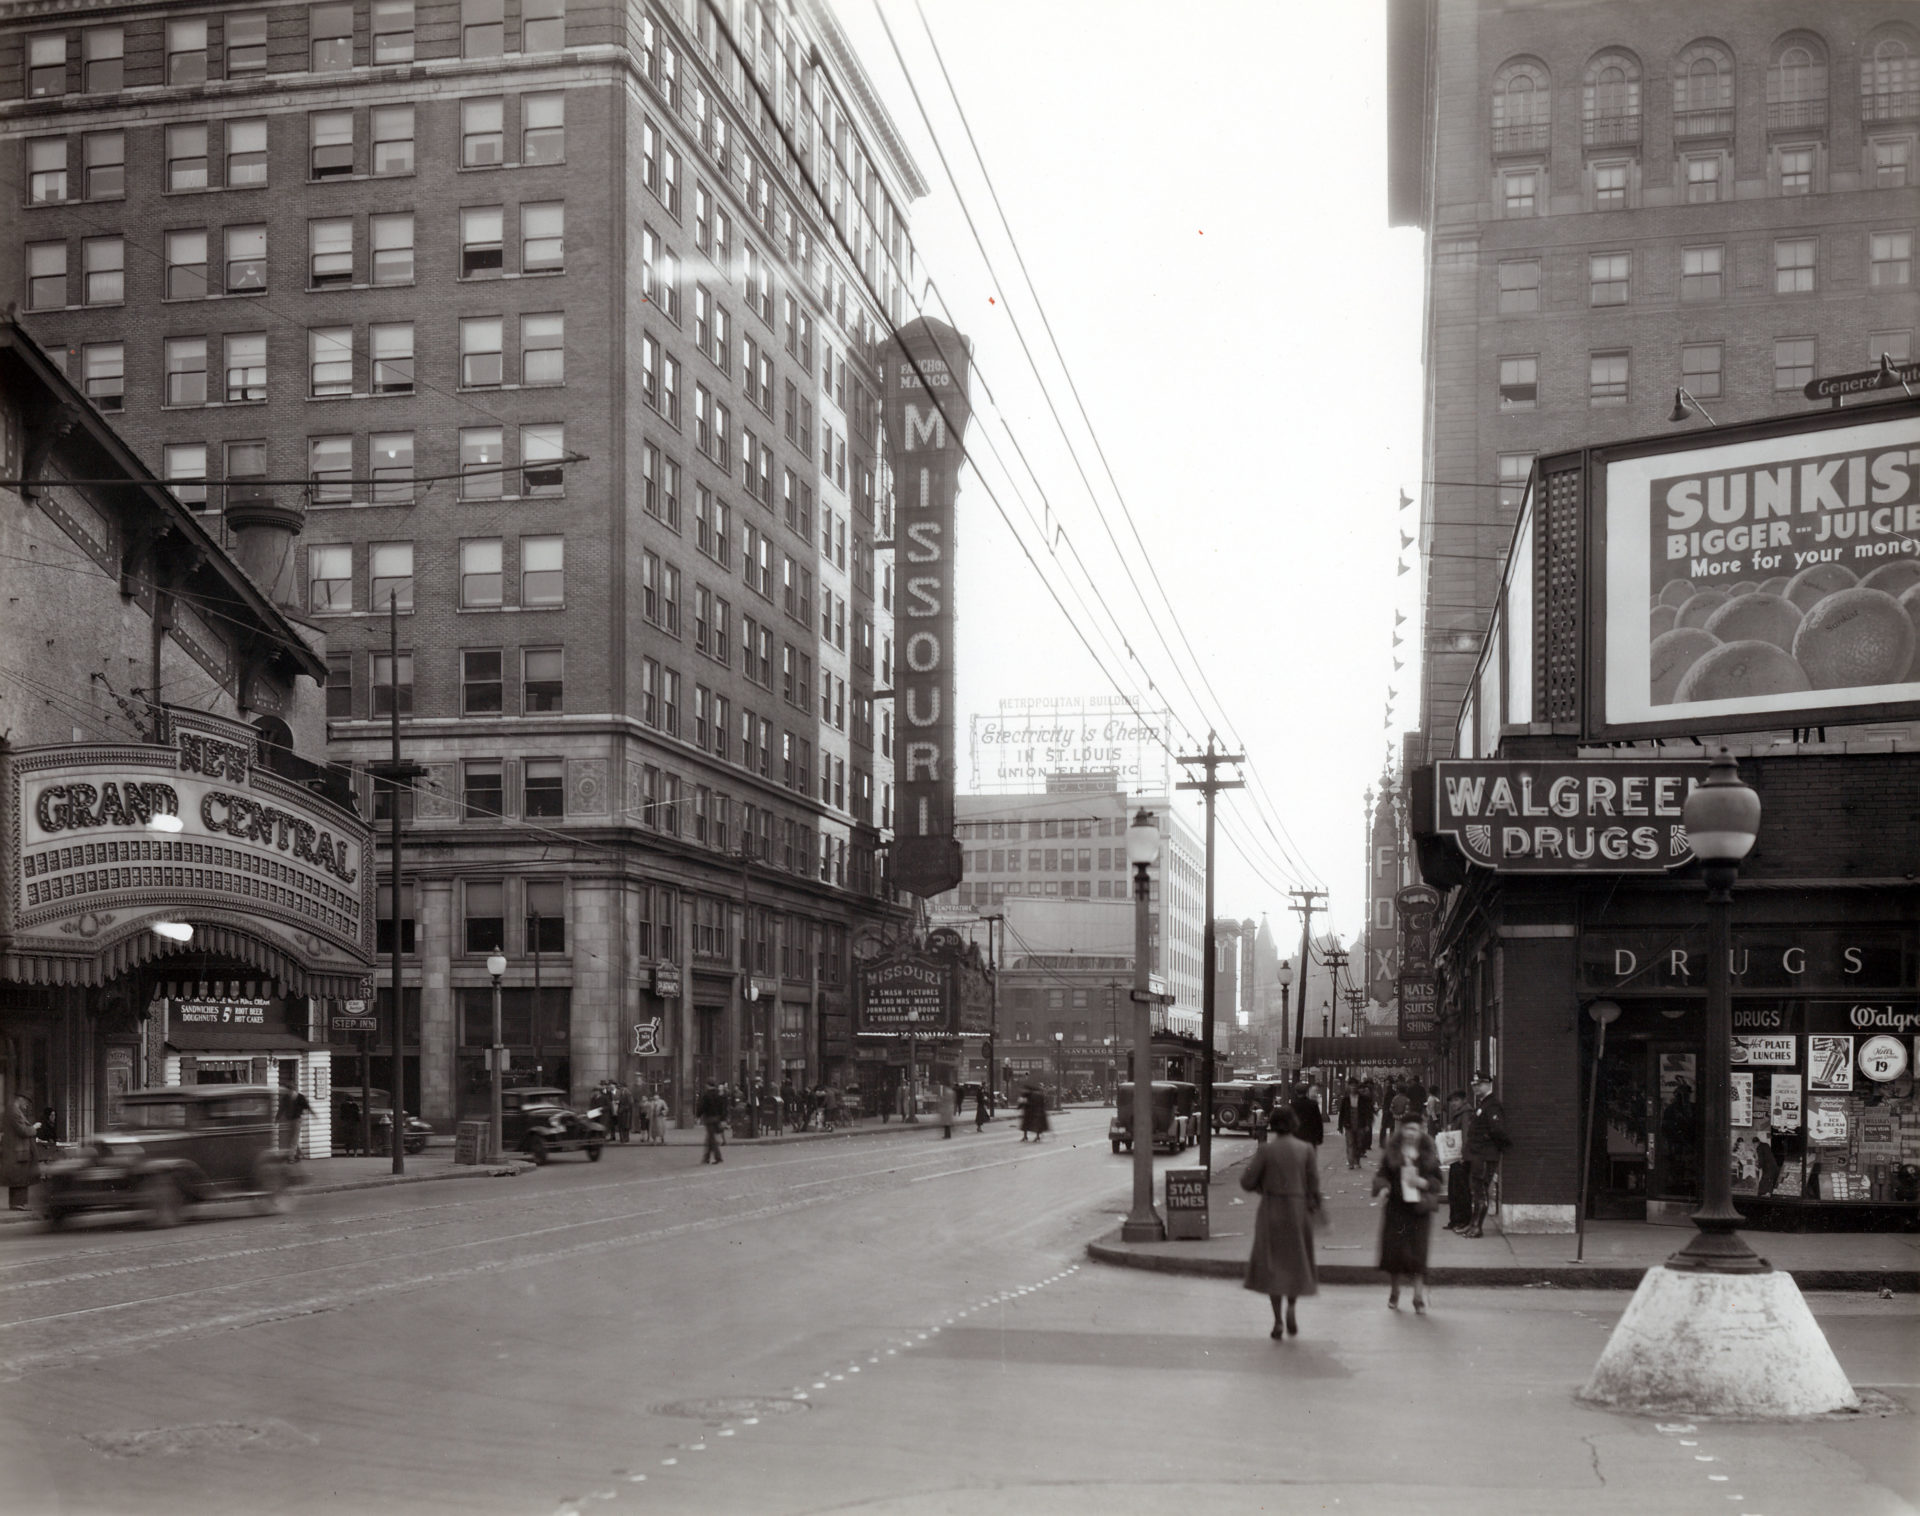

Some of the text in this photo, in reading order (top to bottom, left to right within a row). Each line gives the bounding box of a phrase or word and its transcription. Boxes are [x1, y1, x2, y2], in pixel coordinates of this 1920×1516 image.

[900, 359, 949, 374] FACHON
[1818, 374, 1877, 395] Genera
[1690, 558, 1741, 578] More
[1752, 550, 1782, 570] for
[1794, 547, 1843, 569] your
[903, 402, 946, 837] MISSOURI
[1000, 695, 1140, 710] METROPOLITAN BUILDING
[1103, 719, 1160, 744] Cheap
[180, 732, 250, 784] NEW
[1017, 750, 1034, 763] IN
[997, 767, 1047, 778] UNION
[1445, 775, 1707, 818] WALGREE
[37, 781, 357, 883] GRAND CENTRAL
[1502, 826, 1660, 860] DRUGS
[1374, 845, 1396, 981] FOX
[1615, 946, 1863, 976] DRUGS
[867, 965, 942, 985] MISSOURI
[1404, 984, 1435, 995] HATS
[181, 1005, 219, 1014] SANDWICHES
[1404, 1003, 1435, 1013] SUITS
[182, 1014, 218, 1022] DOUGHNUTS
[334, 1020, 374, 1028] STEP INN
[1734, 1010, 1781, 1027] DRUGS
[1406, 1022, 1435, 1032] SHINE
[1765, 1041, 1791, 1049] PLATE
[1753, 1051, 1791, 1060] LUNCHES
[1169, 1183, 1202, 1194] STAR
[1168, 1195, 1205, 1207] TIMES
